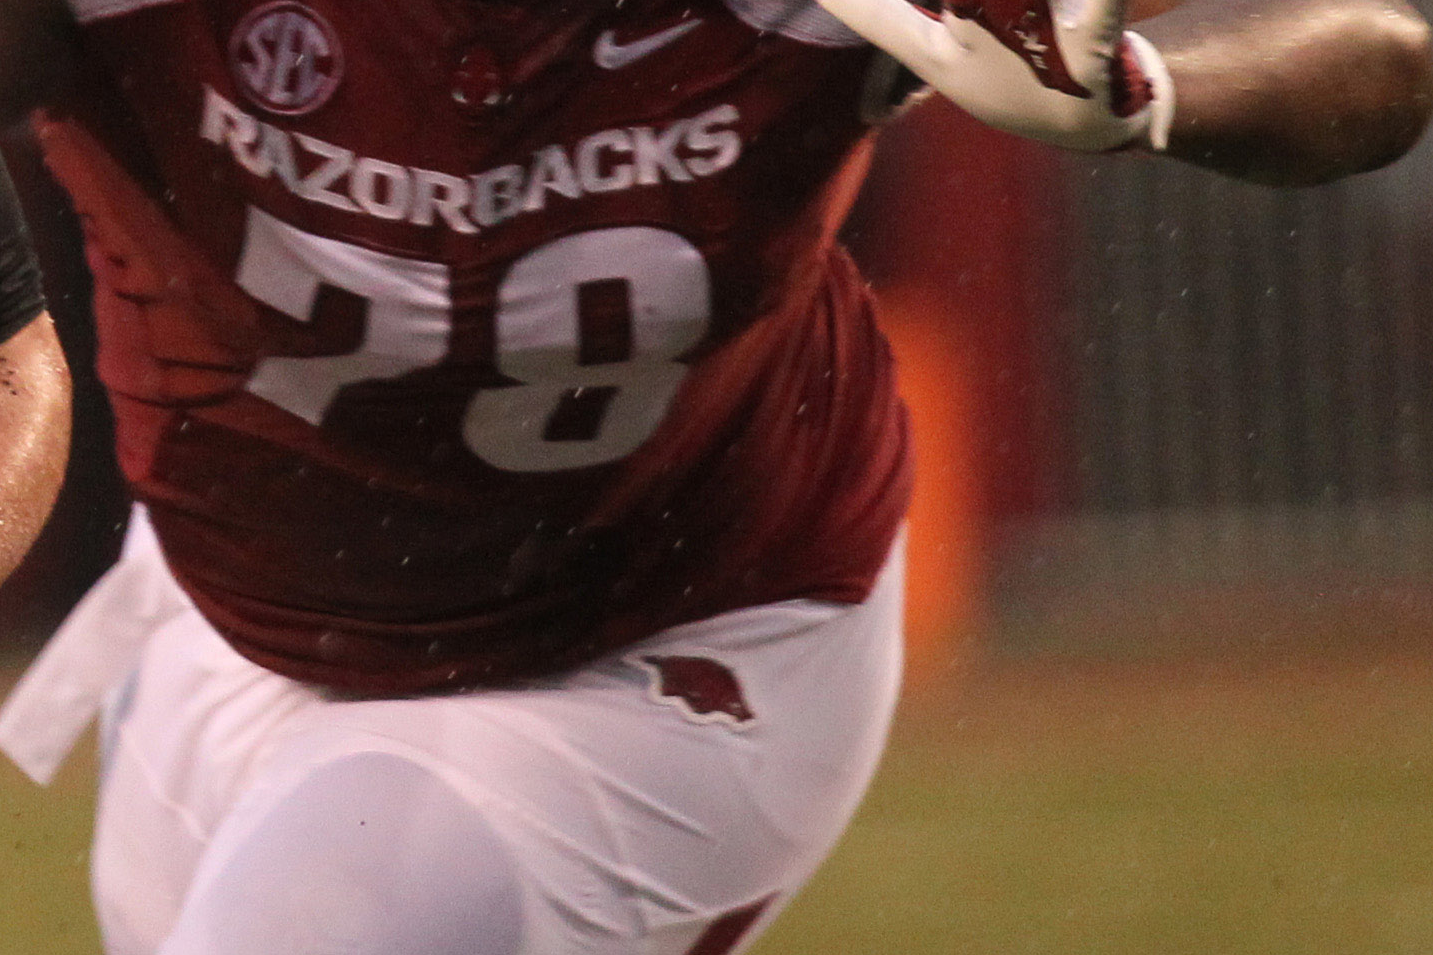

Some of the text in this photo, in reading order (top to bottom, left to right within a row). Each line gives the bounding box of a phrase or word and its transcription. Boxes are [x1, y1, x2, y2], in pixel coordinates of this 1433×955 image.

[236, 10, 333, 107] SEC
[200, 82, 743, 234] RAZORBACKS
[234, 204, 714, 473] 78
